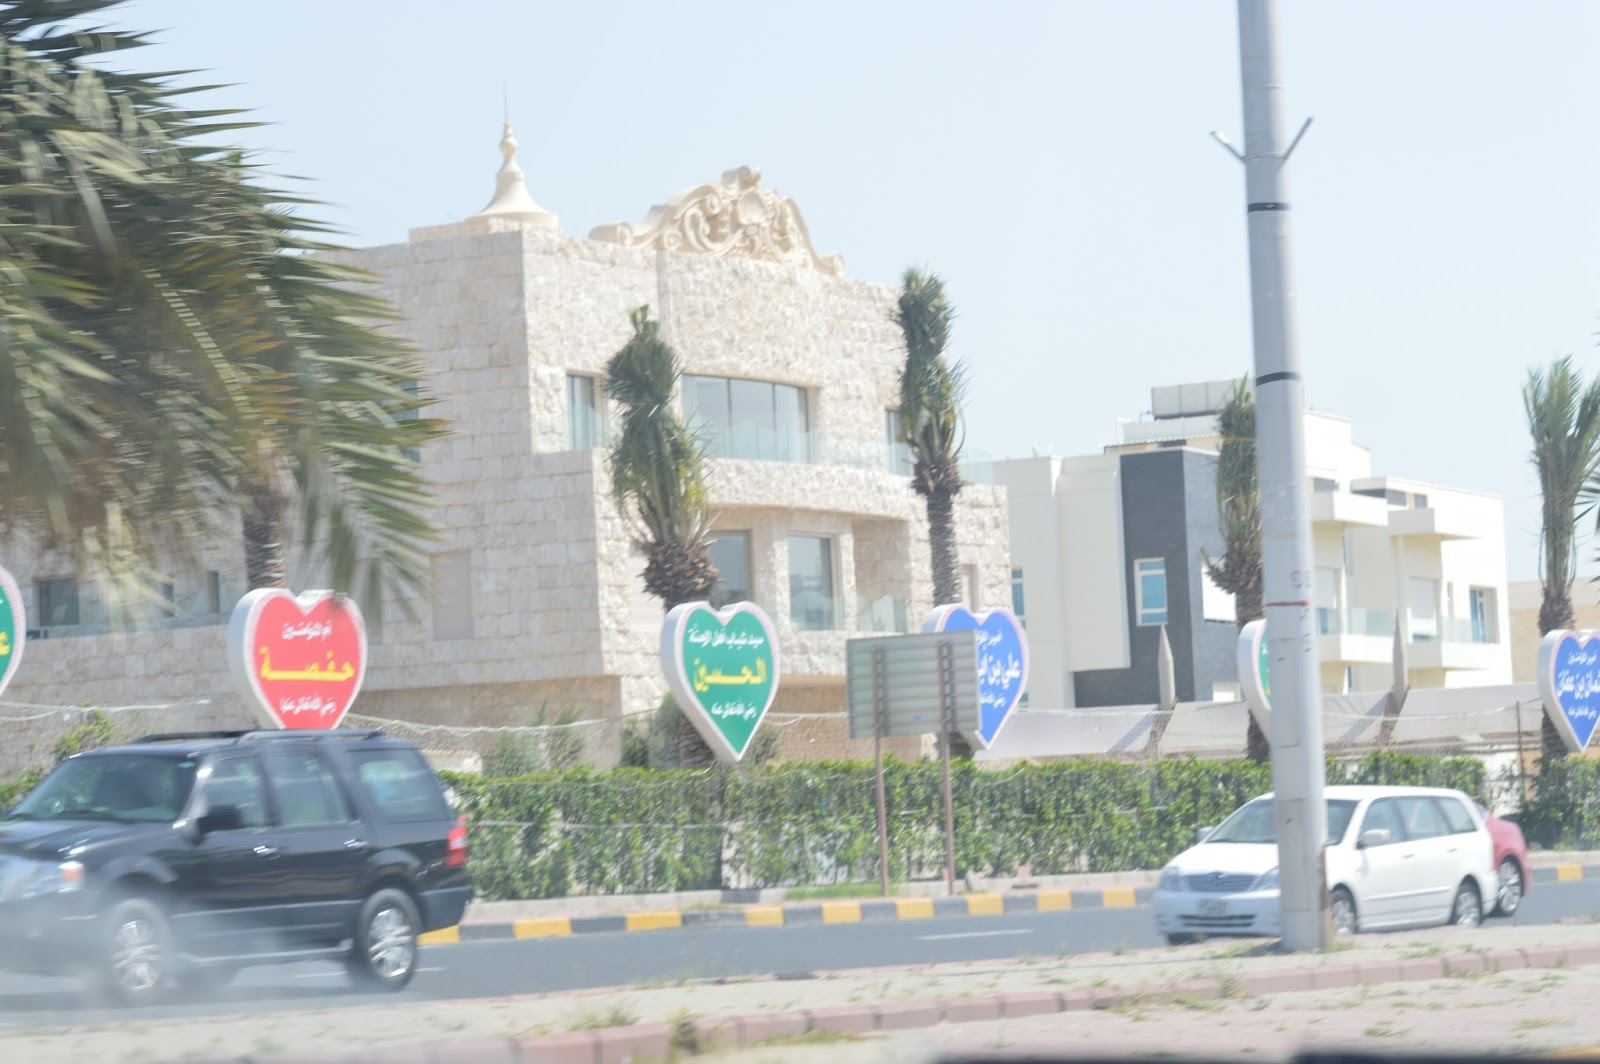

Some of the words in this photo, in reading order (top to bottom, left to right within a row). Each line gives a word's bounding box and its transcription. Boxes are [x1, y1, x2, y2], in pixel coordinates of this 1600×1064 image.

[259, 646, 355, 682] حفصة
[694, 656, 767, 693] الحسين
[1001, 651, 1021, 690] علي
